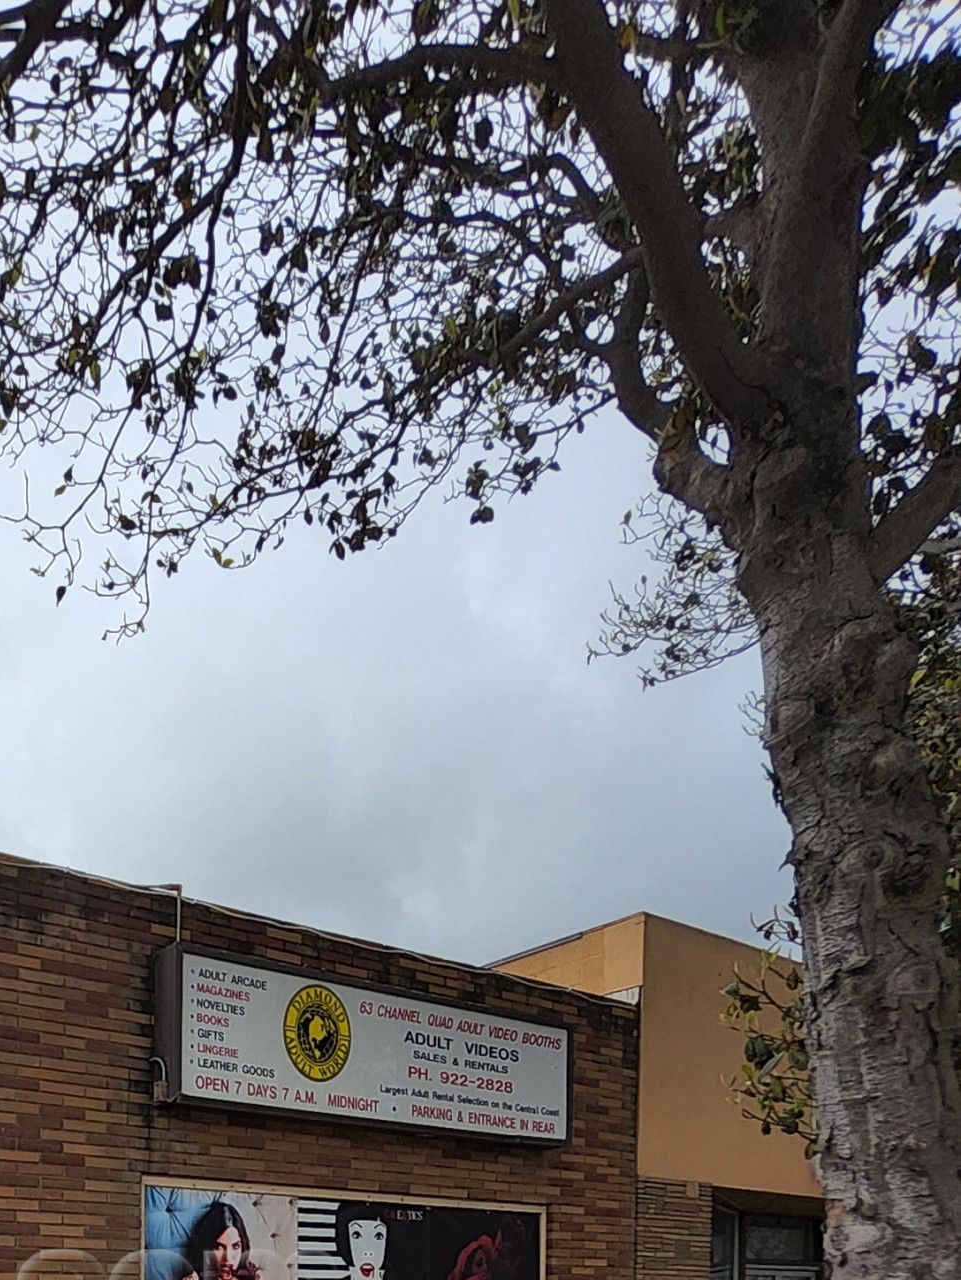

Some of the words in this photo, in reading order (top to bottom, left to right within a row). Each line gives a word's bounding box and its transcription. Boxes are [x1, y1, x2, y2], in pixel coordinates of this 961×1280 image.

[198, 968, 227, 982] ADULT
[231, 974, 267, 990] ARCADE
[196, 983, 250, 1002] MAGAZINES
[292, 988, 346, 1023] DIAMOND
[196, 998, 246, 1016] NOVELTIES
[196, 1013, 230, 1028] BOOKS
[359, 1001, 373, 1016] 63
[377, 1004, 422, 1024] CHANNEL
[428, 1014, 454, 1030] QUAD
[456, 1020, 485, 1036] ADULT
[488, 1026, 518, 1042] VIDEO
[522, 1032, 562, 1050] BOOTHS
[197, 1028, 225, 1042] GIFTS
[404, 1031, 454, 1051] ADULT
[464, 1042, 520, 1063] VIDEOS
[197, 1043, 239, 1058] LINGERIE
[286, 1036, 314, 1077] ADULT
[318, 1043, 348, 1078] WORLD
[413, 1050, 448, 1064] SALES
[452, 1057, 460, 1067] &
[464, 1059, 509, 1074] RENTALS
[197, 1058, 239, 1072] LEATHER
[242, 1064, 276, 1078] GOODS
[408, 1066, 433, 1082] PH.
[440, 1072, 514, 1094] 922-2828
[195, 1075, 230, 1094] OPEN
[235, 1081, 242, 1095] 7
[247, 1082, 278, 1100] DAYS
[282, 1088, 290, 1100] 7
[294, 1090, 318, 1105] A.M.
[328, 1093, 380, 1113] MIDNIGHT
[380, 1084, 408, 1097] Largest
[411, 1088, 430, 1100] Adult
[432, 1092, 454, 1103] Rental
[457, 1095, 489, 1108] Selection
[502, 1100, 512, 1110] the
[514, 1102, 538, 1114] Central
[540, 1107, 560, 1117] Coast
[412, 1104, 453, 1122] PARKING
[457, 1111, 464, 1122] &
[468, 1112, 516, 1130] ENTRANCE
[520, 1118, 528, 1130] IN
[532, 1120, 555, 1134] REAR
